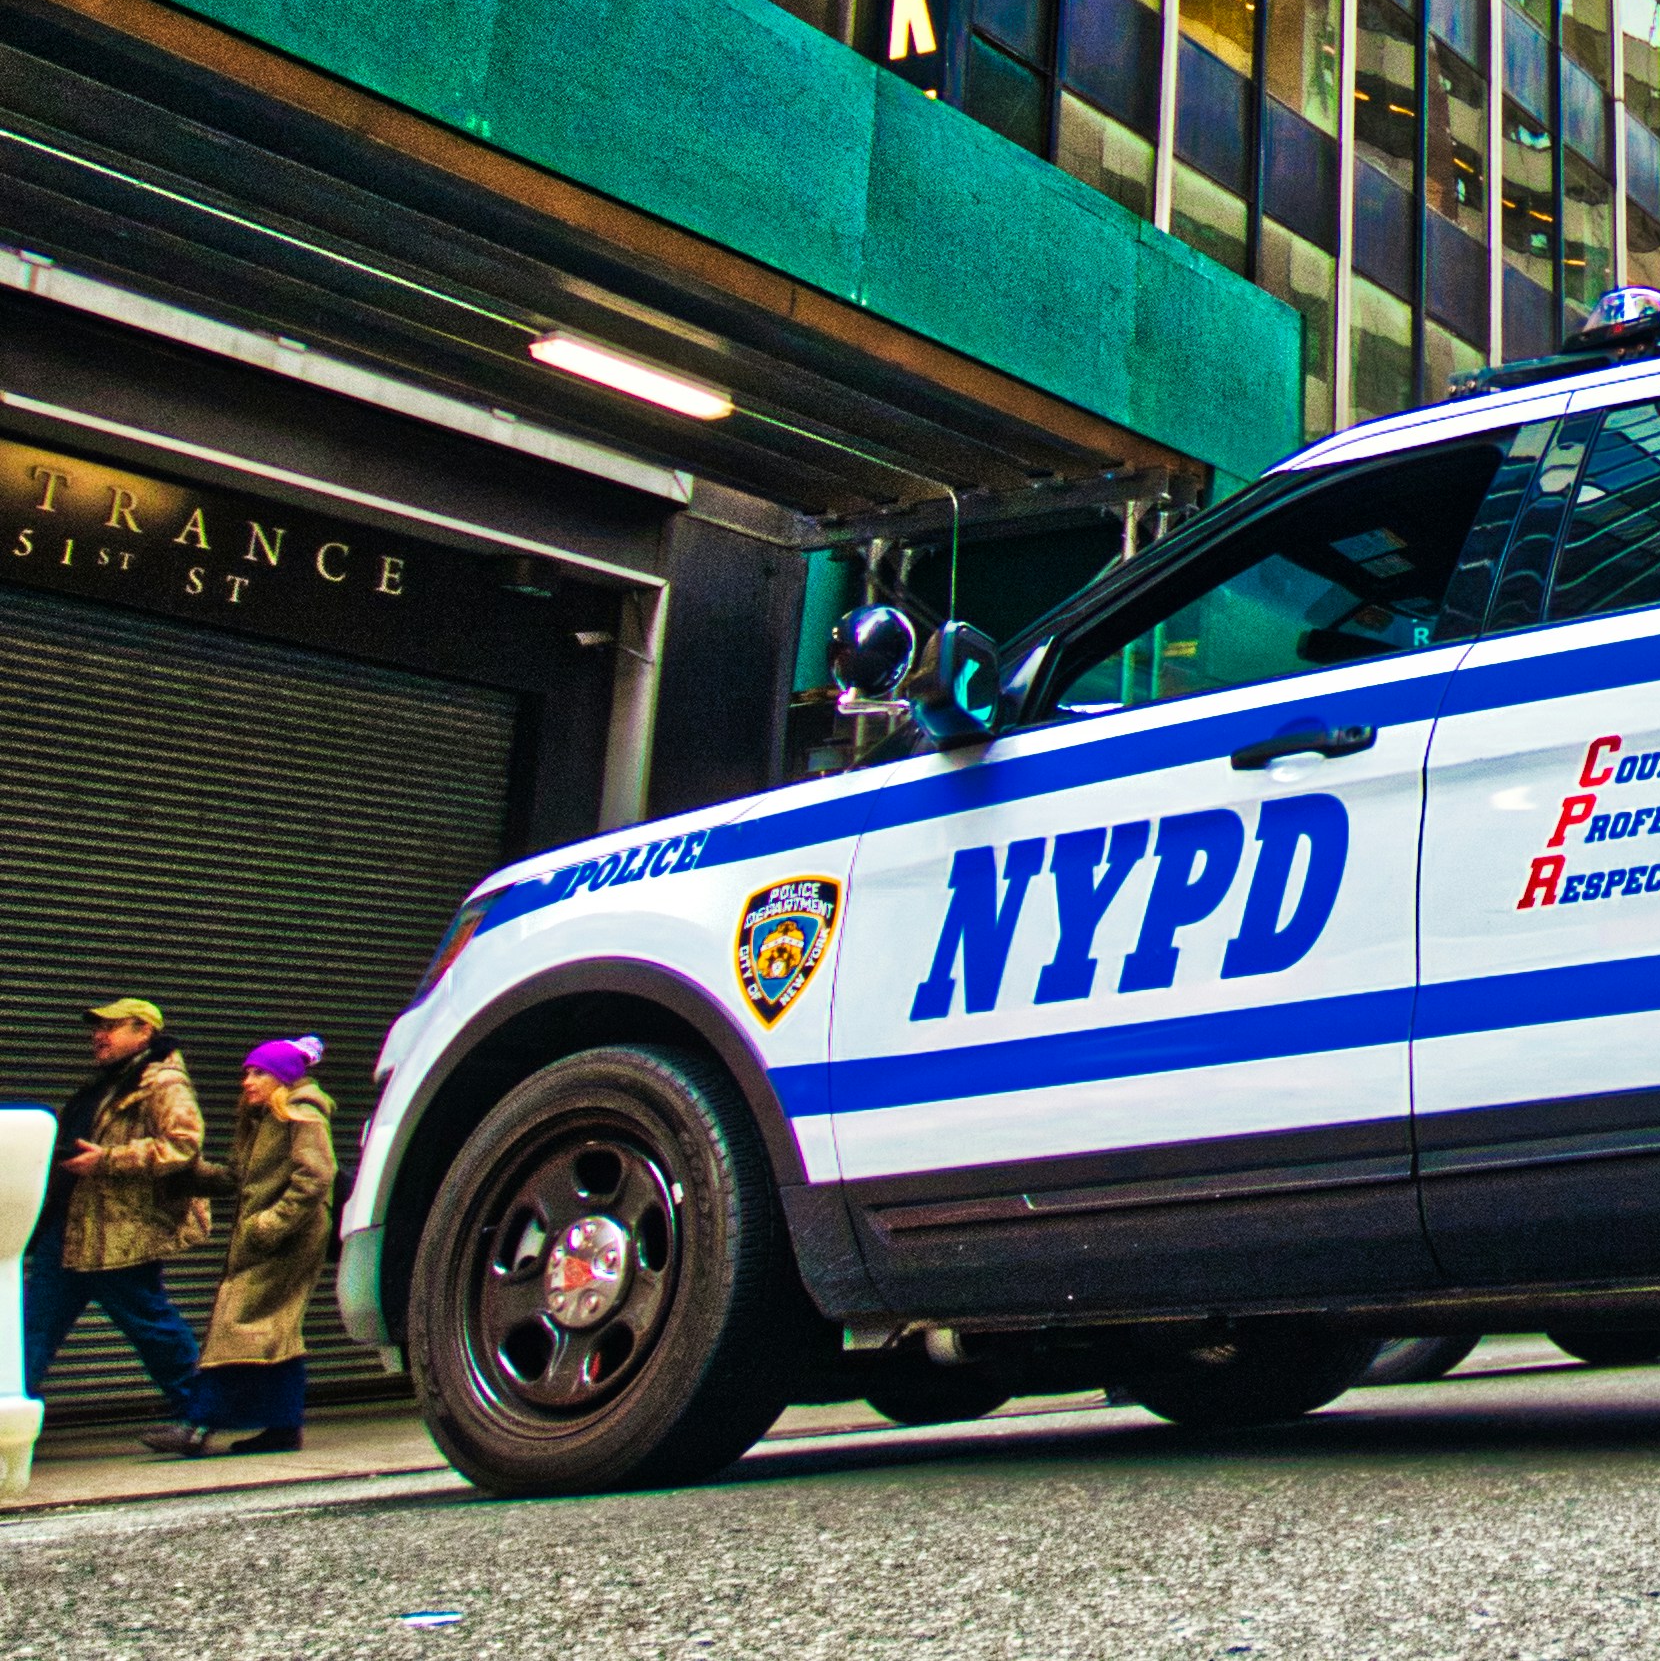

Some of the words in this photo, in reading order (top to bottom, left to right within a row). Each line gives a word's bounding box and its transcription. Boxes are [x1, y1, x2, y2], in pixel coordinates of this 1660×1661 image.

[29, 465, 408, 597] TRANCE
[184, 565, 250, 604] ST
[560, 830, 711, 901] POLICE
[768, 881, 822, 904] POLICE
[743, 896, 835, 930] DEPARTMENT
[908, 792, 1350, 1022] NYPD
[738, 944, 753, 979] CITY
[747, 983, 764, 1001] OF
[778, 972, 806, 1006] NEW
[804, 926, 831, 968] YORK
